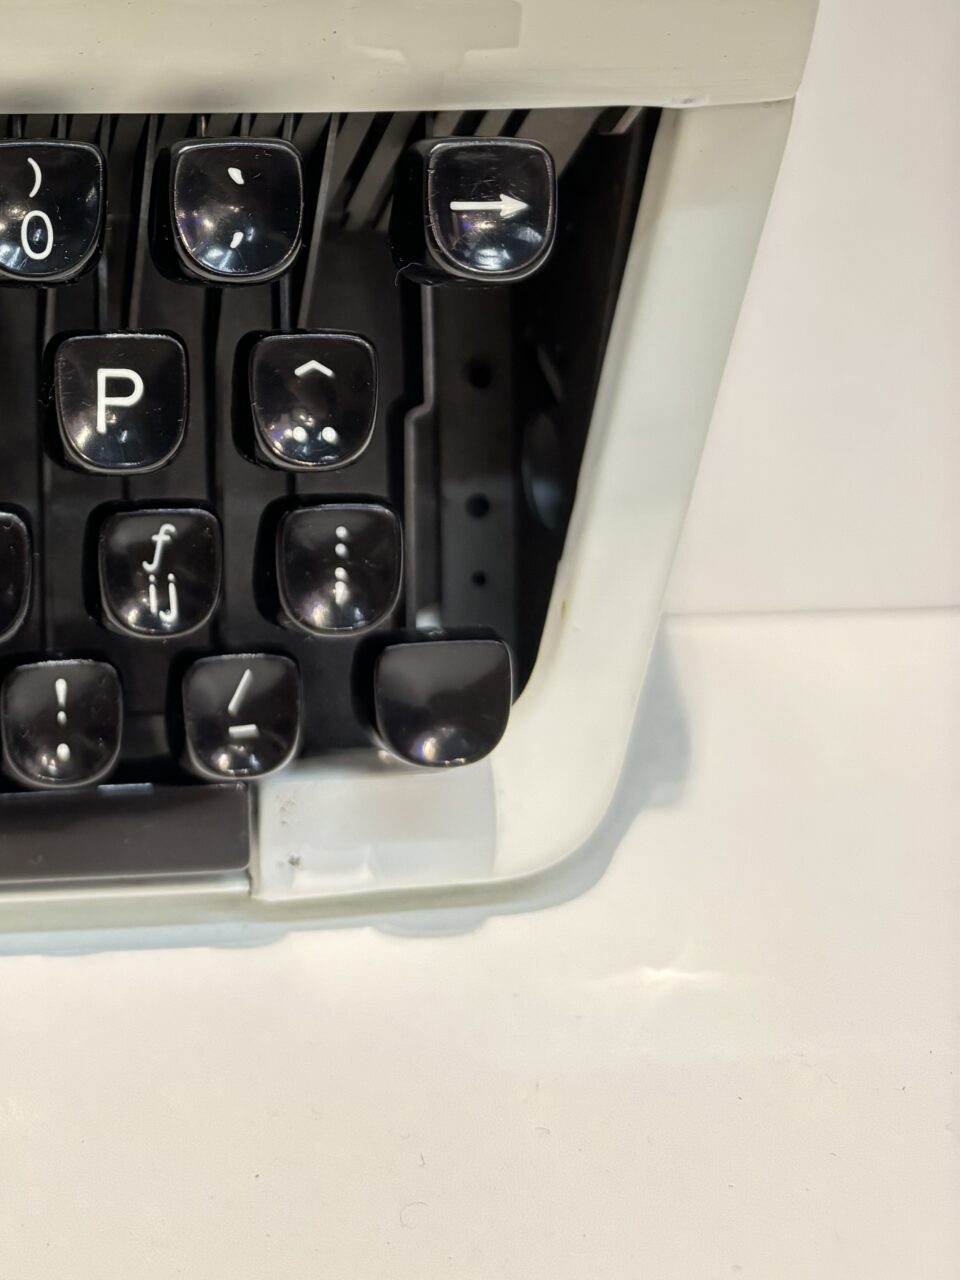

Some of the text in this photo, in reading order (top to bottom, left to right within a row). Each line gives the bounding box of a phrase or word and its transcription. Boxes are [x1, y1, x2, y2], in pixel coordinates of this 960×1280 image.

[27, 157, 42, 198] )
[21, 209, 54, 261] 0
[96, 368, 144, 434] P
